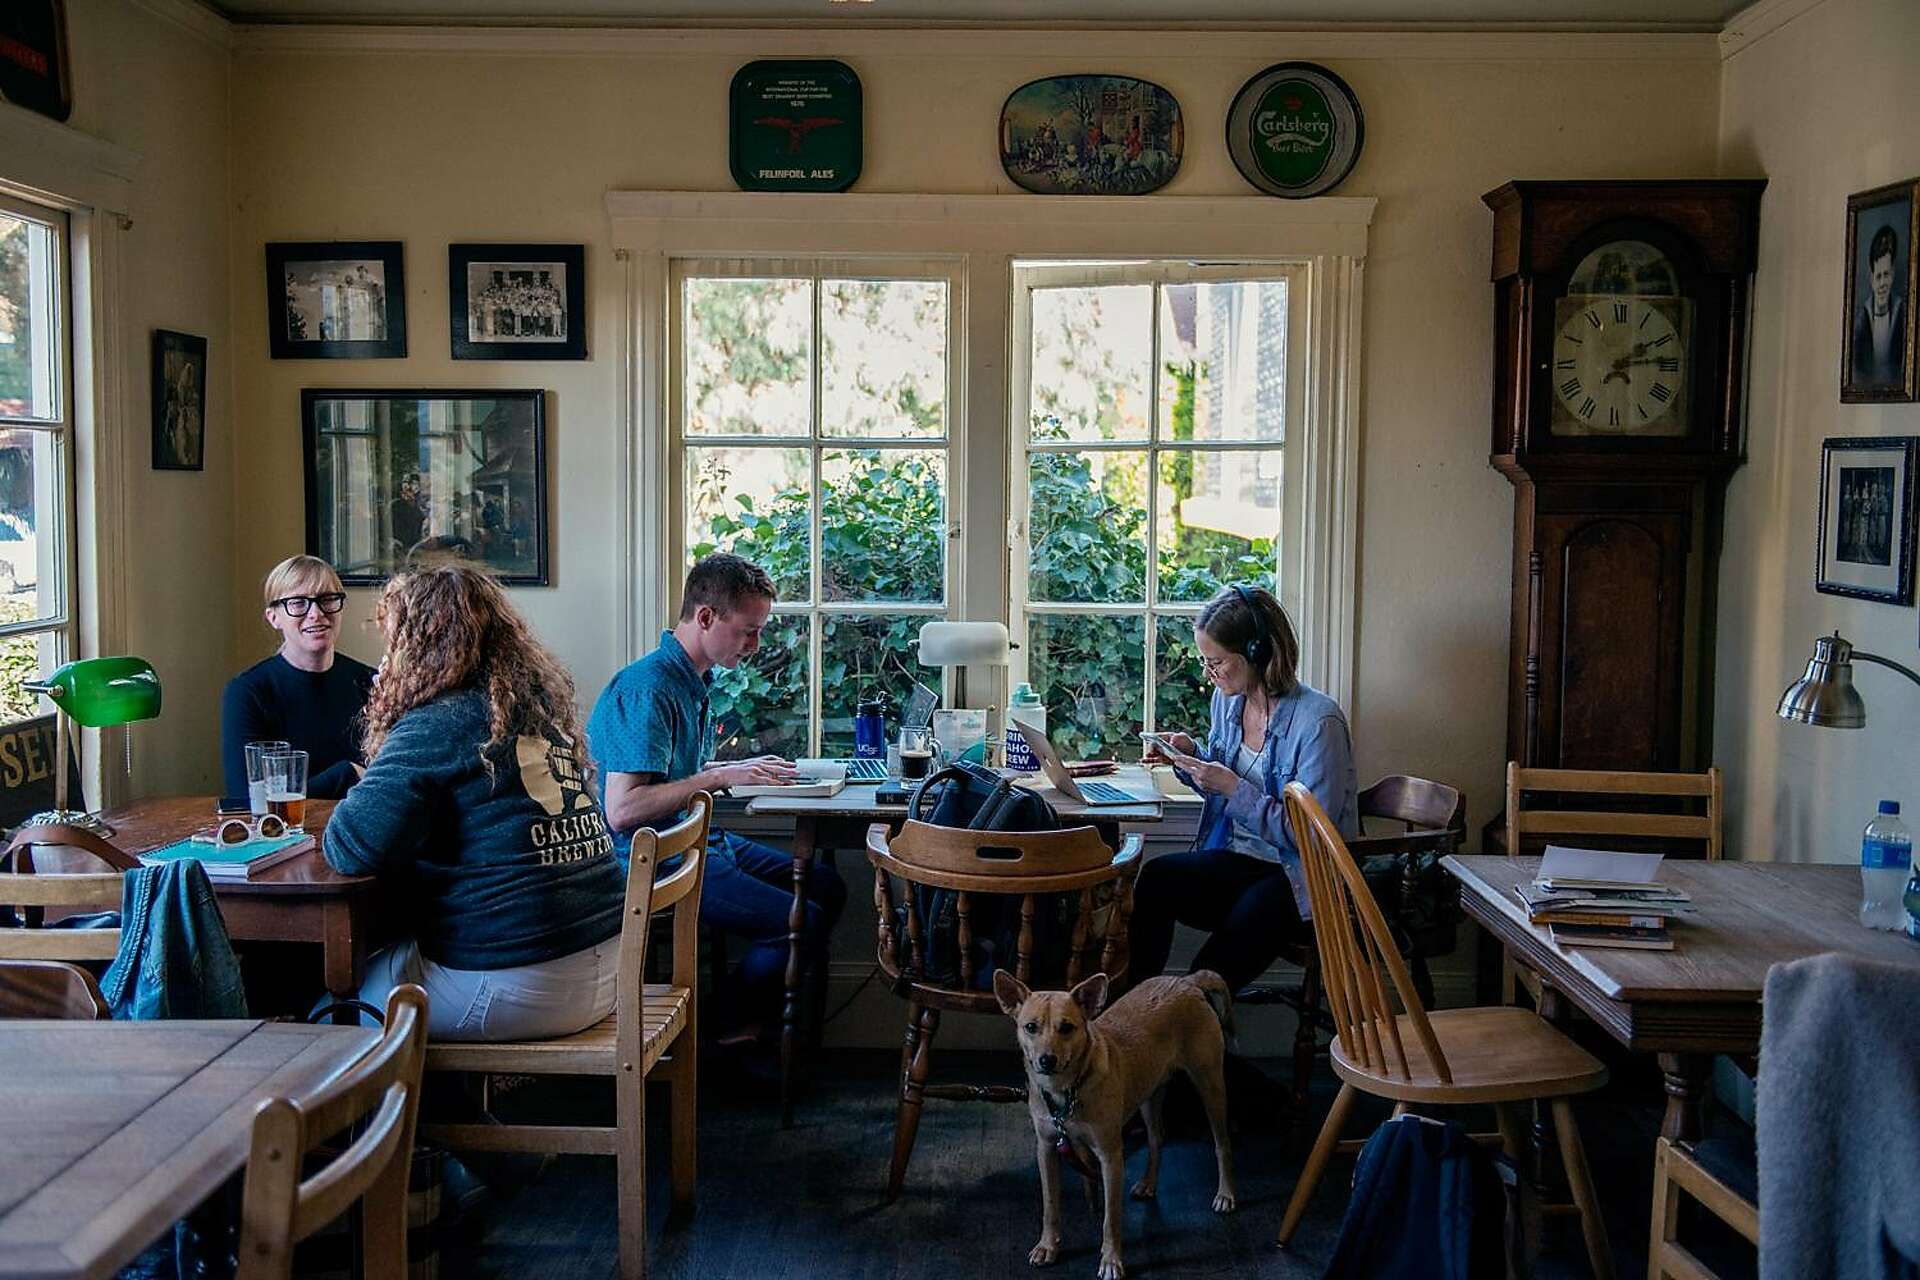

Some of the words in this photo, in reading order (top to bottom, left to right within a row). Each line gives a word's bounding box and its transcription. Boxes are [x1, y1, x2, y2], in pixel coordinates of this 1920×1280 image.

[1257, 110, 1330, 147] Carlsberg
[759, 169, 806, 179] FELINFOEL
[810, 169, 835, 179] ALES
[1006, 730, 1026, 743] RIN
[1006, 743, 1033, 754] AHO
[1007, 753, 1030, 765] REW
[541, 833, 614, 866] BREWIN
